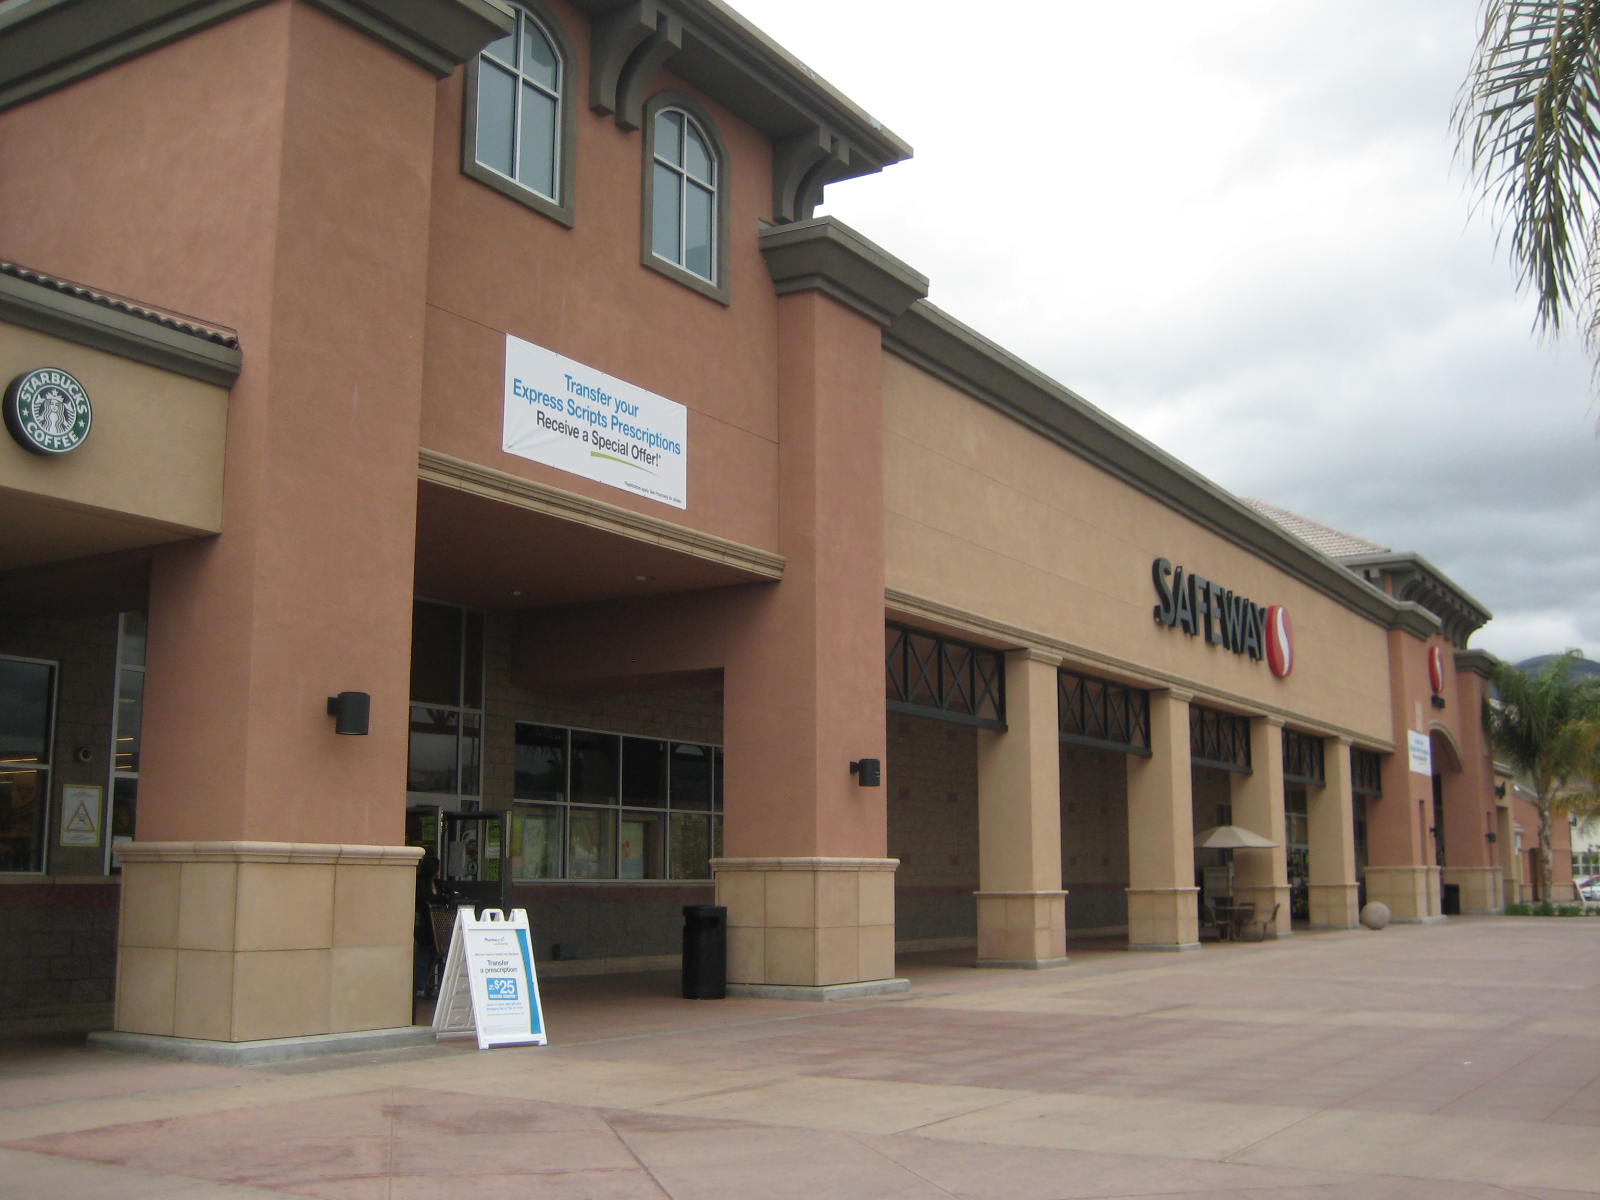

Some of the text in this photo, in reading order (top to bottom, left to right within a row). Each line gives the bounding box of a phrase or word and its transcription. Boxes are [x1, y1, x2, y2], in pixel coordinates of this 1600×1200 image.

[21, 372, 88, 414] STARBUCKS
[564, 374, 639, 418] Transfer your
[27, 422, 79, 449] COFFEE
[513, 378, 682, 455] Express Scripts Prescriptions
[536, 410, 580, 439] Receive
[582, 430, 589, 443] a
[591, 430, 629, 457] Special
[1152, 557, 1268, 661] SAFEWAY
[485, 966, 518, 974] prescription
[487, 959, 509, 967] Transfer
[494, 979, 516, 994] $25
